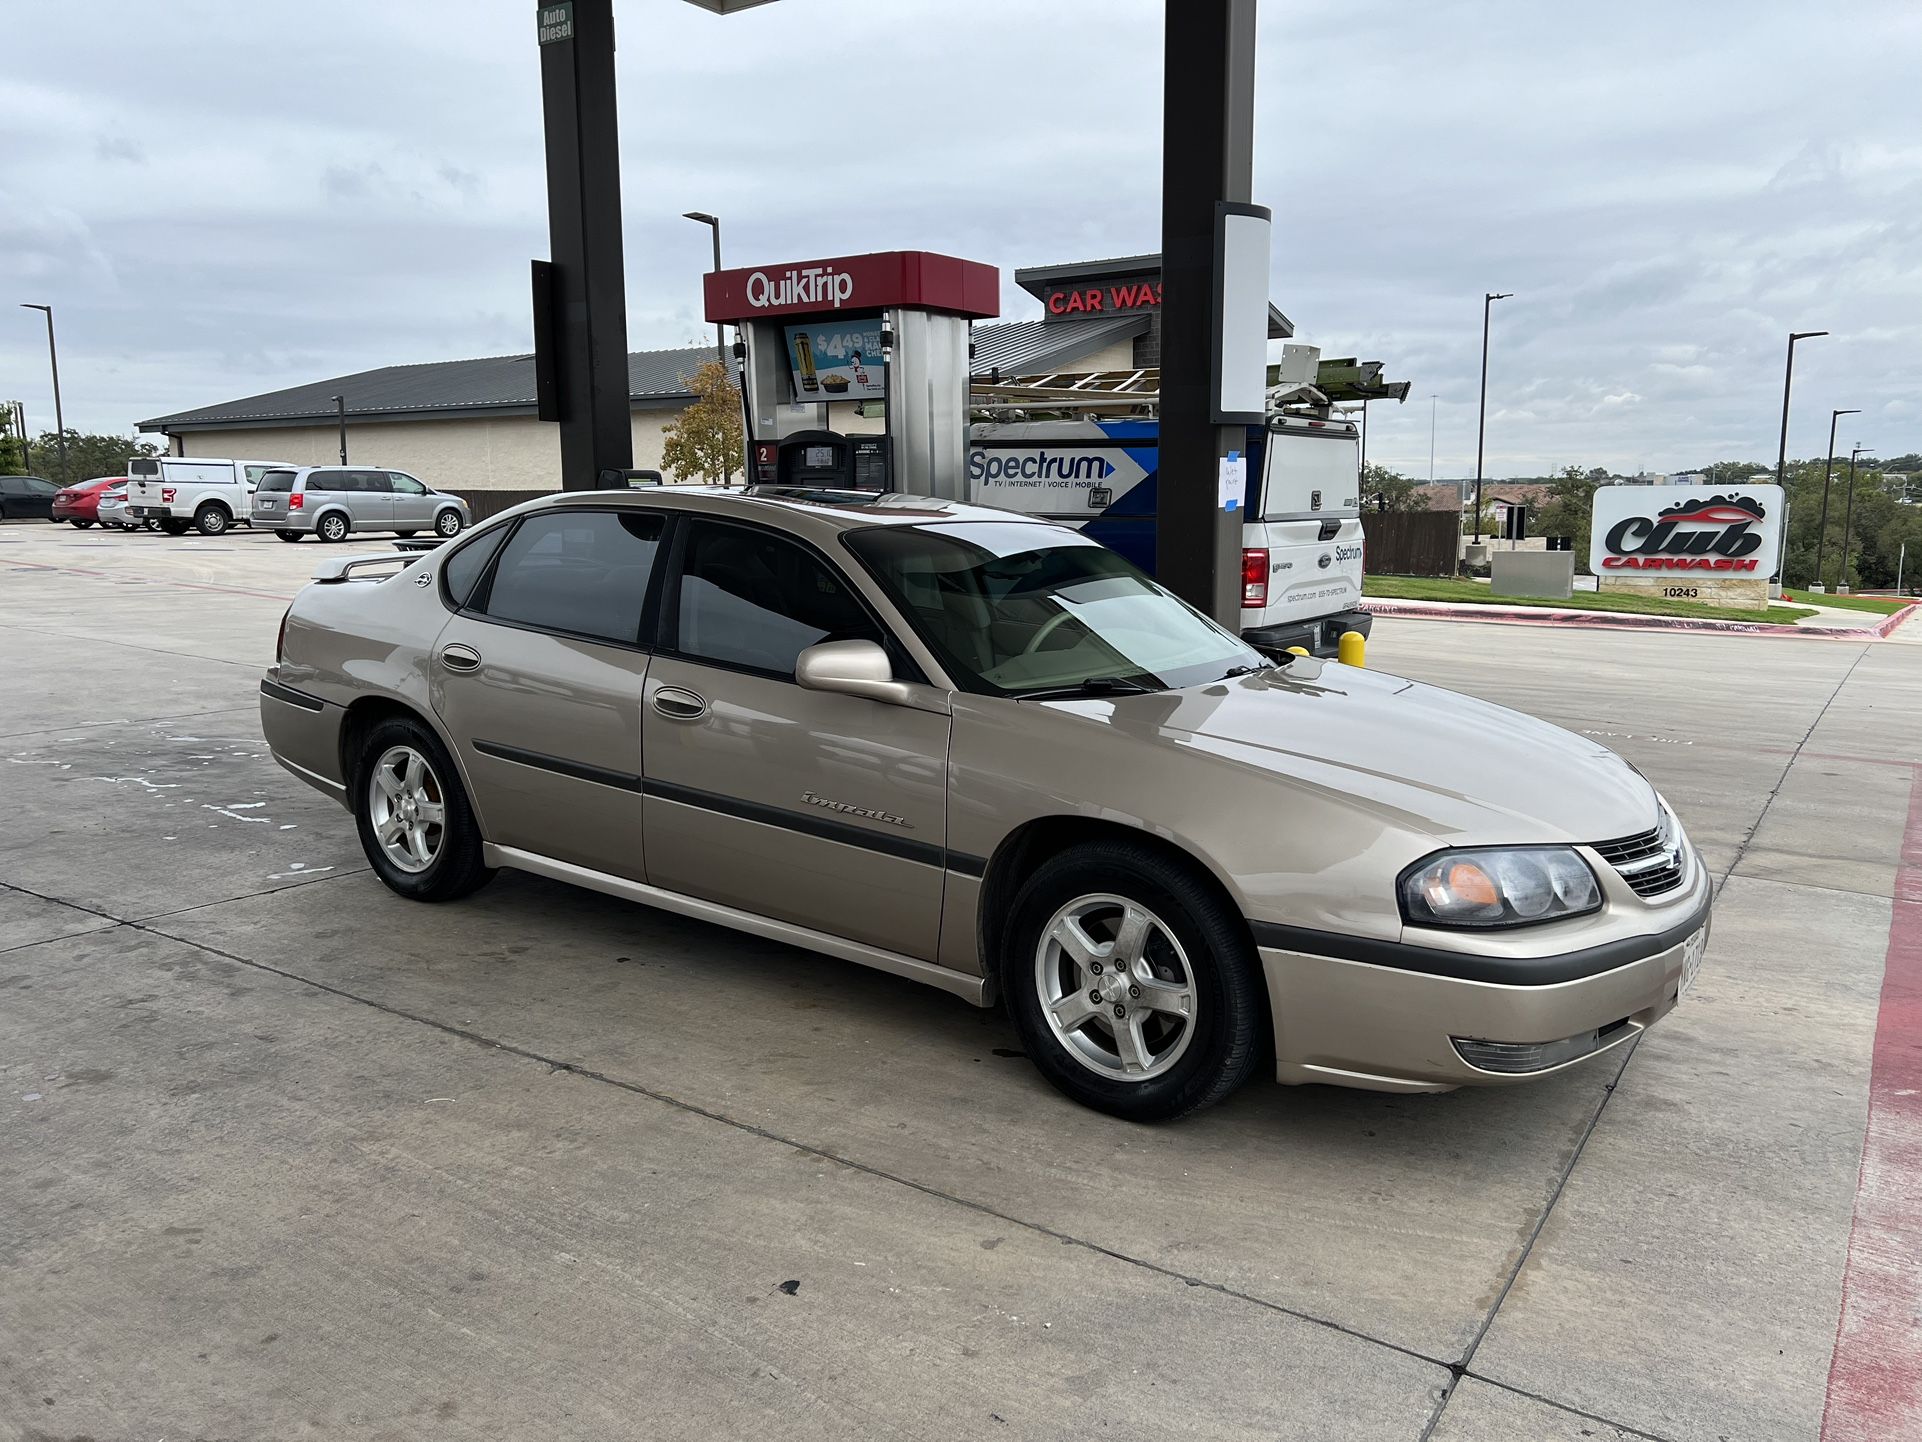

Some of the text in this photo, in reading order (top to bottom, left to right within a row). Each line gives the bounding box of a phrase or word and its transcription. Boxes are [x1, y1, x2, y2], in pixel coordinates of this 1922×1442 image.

[543, 9, 566, 26] Auto
[540, 21, 572, 42] Diesel
[746, 266, 853, 308] QuikTrip
[1048, 282, 1162, 314] CAR WA
[865, 342, 882, 350] MA
[760, 447, 767, 461] 2
[969, 450, 1105, 486] Spectrum
[1008, 480, 1042, 488] INTERNET
[1604, 516, 1763, 557] Club
[1335, 545, 1361, 564] Spectrum
[1601, 556, 1760, 572] CARWASH
[1287, 592, 1317, 603] spectrum.com
[1663, 588, 1698, 598] 10243
